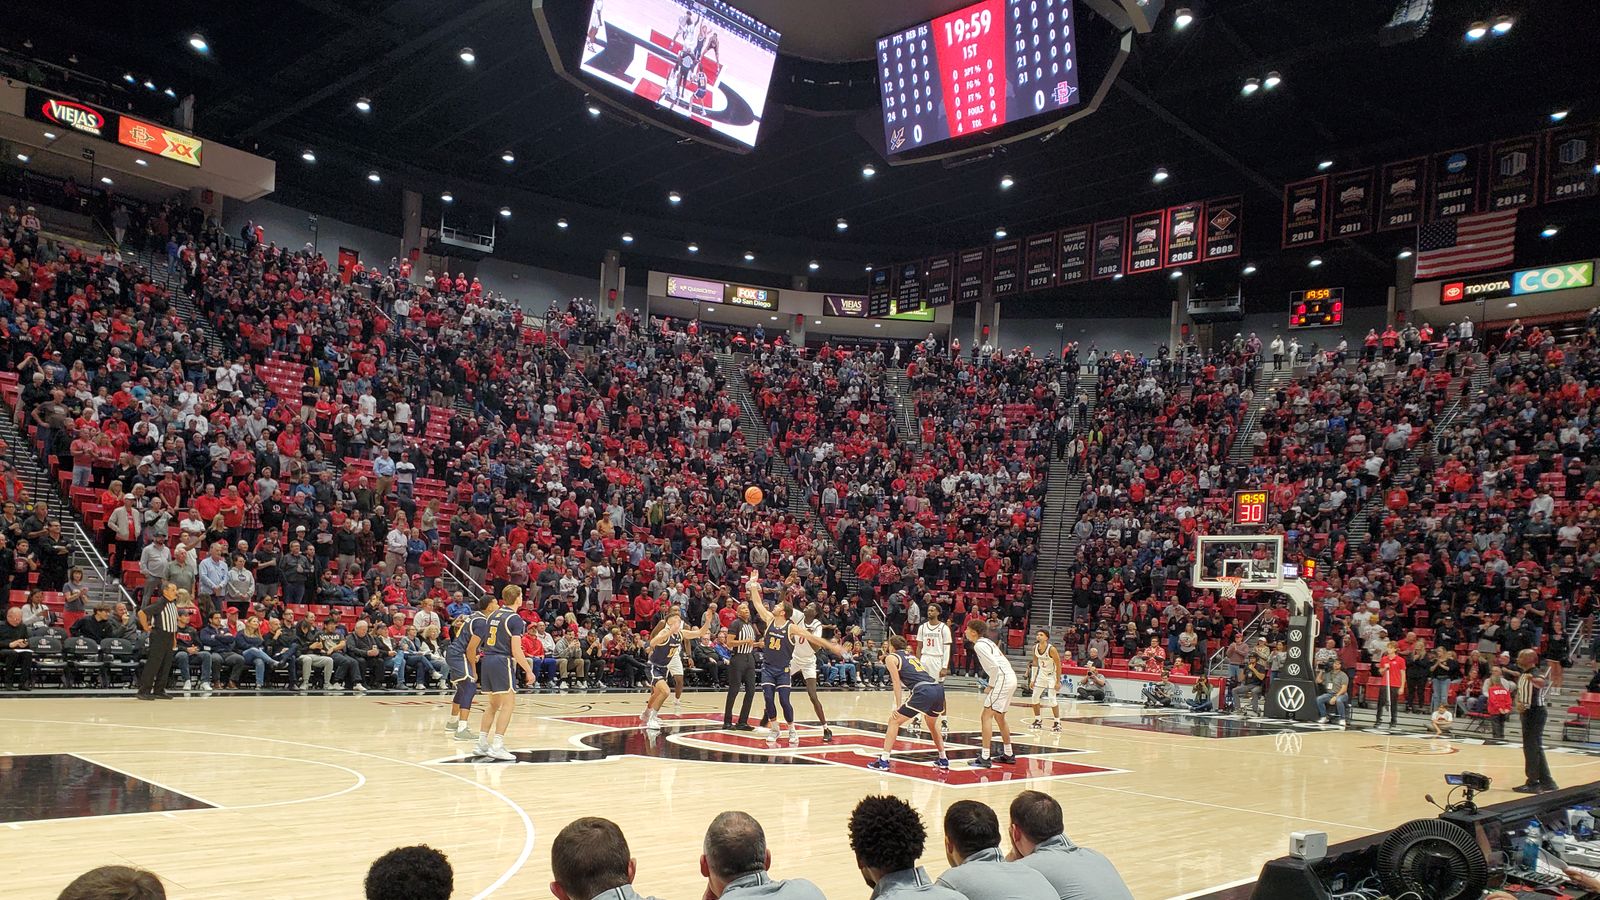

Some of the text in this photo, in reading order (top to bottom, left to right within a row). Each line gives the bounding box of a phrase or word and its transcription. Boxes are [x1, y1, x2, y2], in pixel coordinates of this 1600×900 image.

[945, 9, 992, 46] 19:59
[1016, 8, 1068, 35] 2 0 0 0
[893, 34, 902, 46] PTS
[906, 30, 916, 40] REB
[918, 26, 928, 36] FLS
[1016, 25, 1070, 52] 10 0 0 0
[882, 40, 926, 63] 3 0 0 0
[962, 44, 978, 60] 1ST
[1017, 42, 1070, 68] 21 0 0 0
[898, 63, 902, 73] 0
[911, 58, 916, 68] 0
[923, 54, 928, 66] 0
[952, 70, 958, 80] 0
[987, 59, 992, 70] 0
[1018, 58, 1072, 84] 31 0 0 0
[884, 70, 930, 92] 12 0 0 0
[954, 83, 959, 94] 0
[988, 72, 994, 84] 0
[886, 86, 931, 108] 13 0 0 0
[955, 96, 960, 107] 0
[968, 94, 974, 103] FT
[990, 86, 994, 97] 0
[1035, 90, 1044, 110] 0
[50, 99, 98, 128] VIEJAS
[888, 100, 932, 122] 24 0 0 0
[956, 100, 996, 120] 0 FOULS 0
[958, 122, 963, 132] 4
[992, 113, 998, 124] 4
[914, 124, 922, 142] 0
[170, 142, 193, 158] XX
[1438, 190, 1461, 200] SWEET
[1556, 182, 1586, 195] 2014
[80, 198, 87, 207] F
[1496, 194, 1526, 207] 2012
[1442, 204, 1466, 216] 2011
[1390, 213, 1412, 224] 2011
[1292, 231, 1314, 242] 2010
[1340, 223, 1360, 234] 2011
[1063, 242, 1086, 252] WAC
[1210, 244, 1233, 256] 2009
[1134, 258, 1156, 268] 2006
[1171, 251, 1194, 262] 2006
[1098, 264, 1118, 274] 2002
[1520, 264, 1588, 292] COX
[738, 288, 765, 300] FOX 5
[996, 284, 1012, 292] 1977
[1306, 289, 1330, 300] 19:59
[1465, 280, 1511, 295] TOYOTA
[742, 298, 754, 306] San
[754, 299, 772, 308] Diego
[841, 298, 862, 310] VIEJAS
[1241, 493, 1266, 504] 19:59
[1240, 504, 1262, 521] 30
[486, 626, 498, 646] 3
[926, 638, 935, 647] 31
